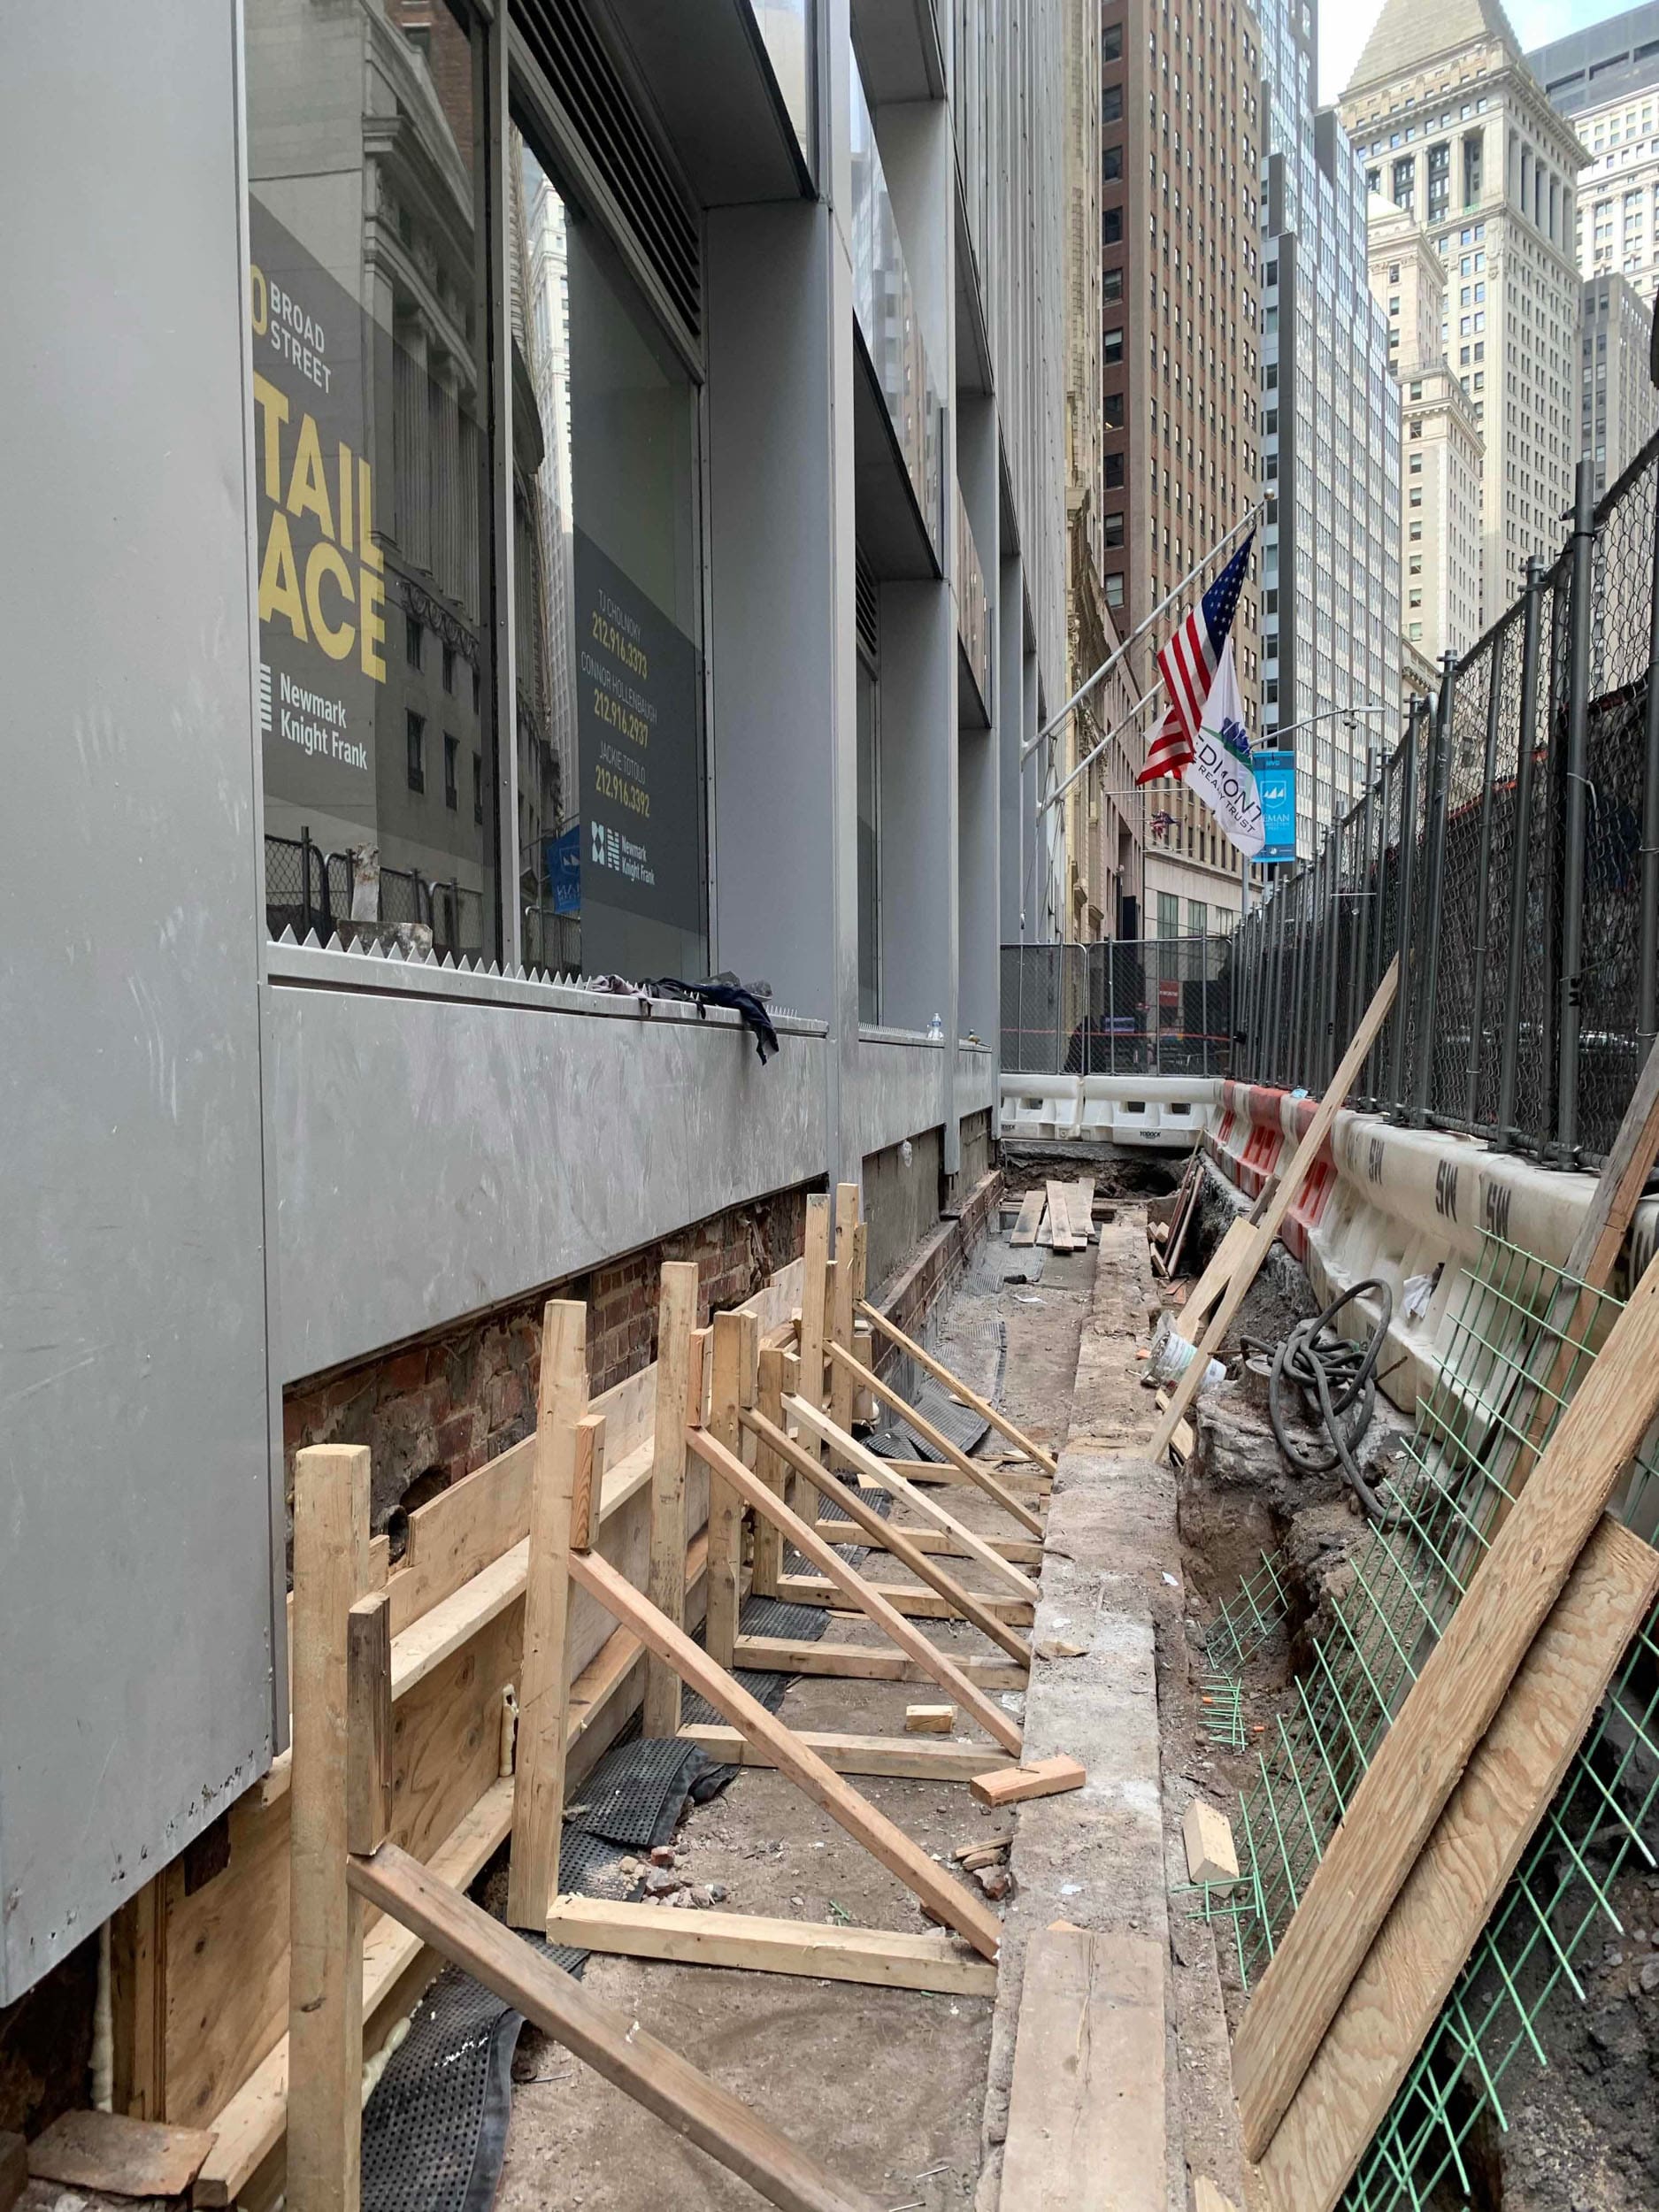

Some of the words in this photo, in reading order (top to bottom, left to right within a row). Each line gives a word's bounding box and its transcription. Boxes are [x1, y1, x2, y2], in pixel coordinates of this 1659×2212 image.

[271, 280, 325, 354] BROAD
[271, 319, 332, 395] STREET
[253, 370, 384, 575] TAIL
[258, 509, 387, 685] ACE
[581, 649, 612, 689] CONNOR
[592, 610, 649, 680] 212.916.3373
[280, 672, 348, 729] Newmark
[595, 687, 649, 749] 212.916.2937
[280, 709, 329, 756] Knight
[332, 732, 368, 771] Frank
[595, 764, 650, 819] 212.916.3392
[1225, 800, 1256, 833] TRUST
[1263, 813, 1290, 823] EMAN
[621, 834, 647, 863] Newmark
[621, 856, 641, 882] Knight
[640, 864, 656, 886] Frank
